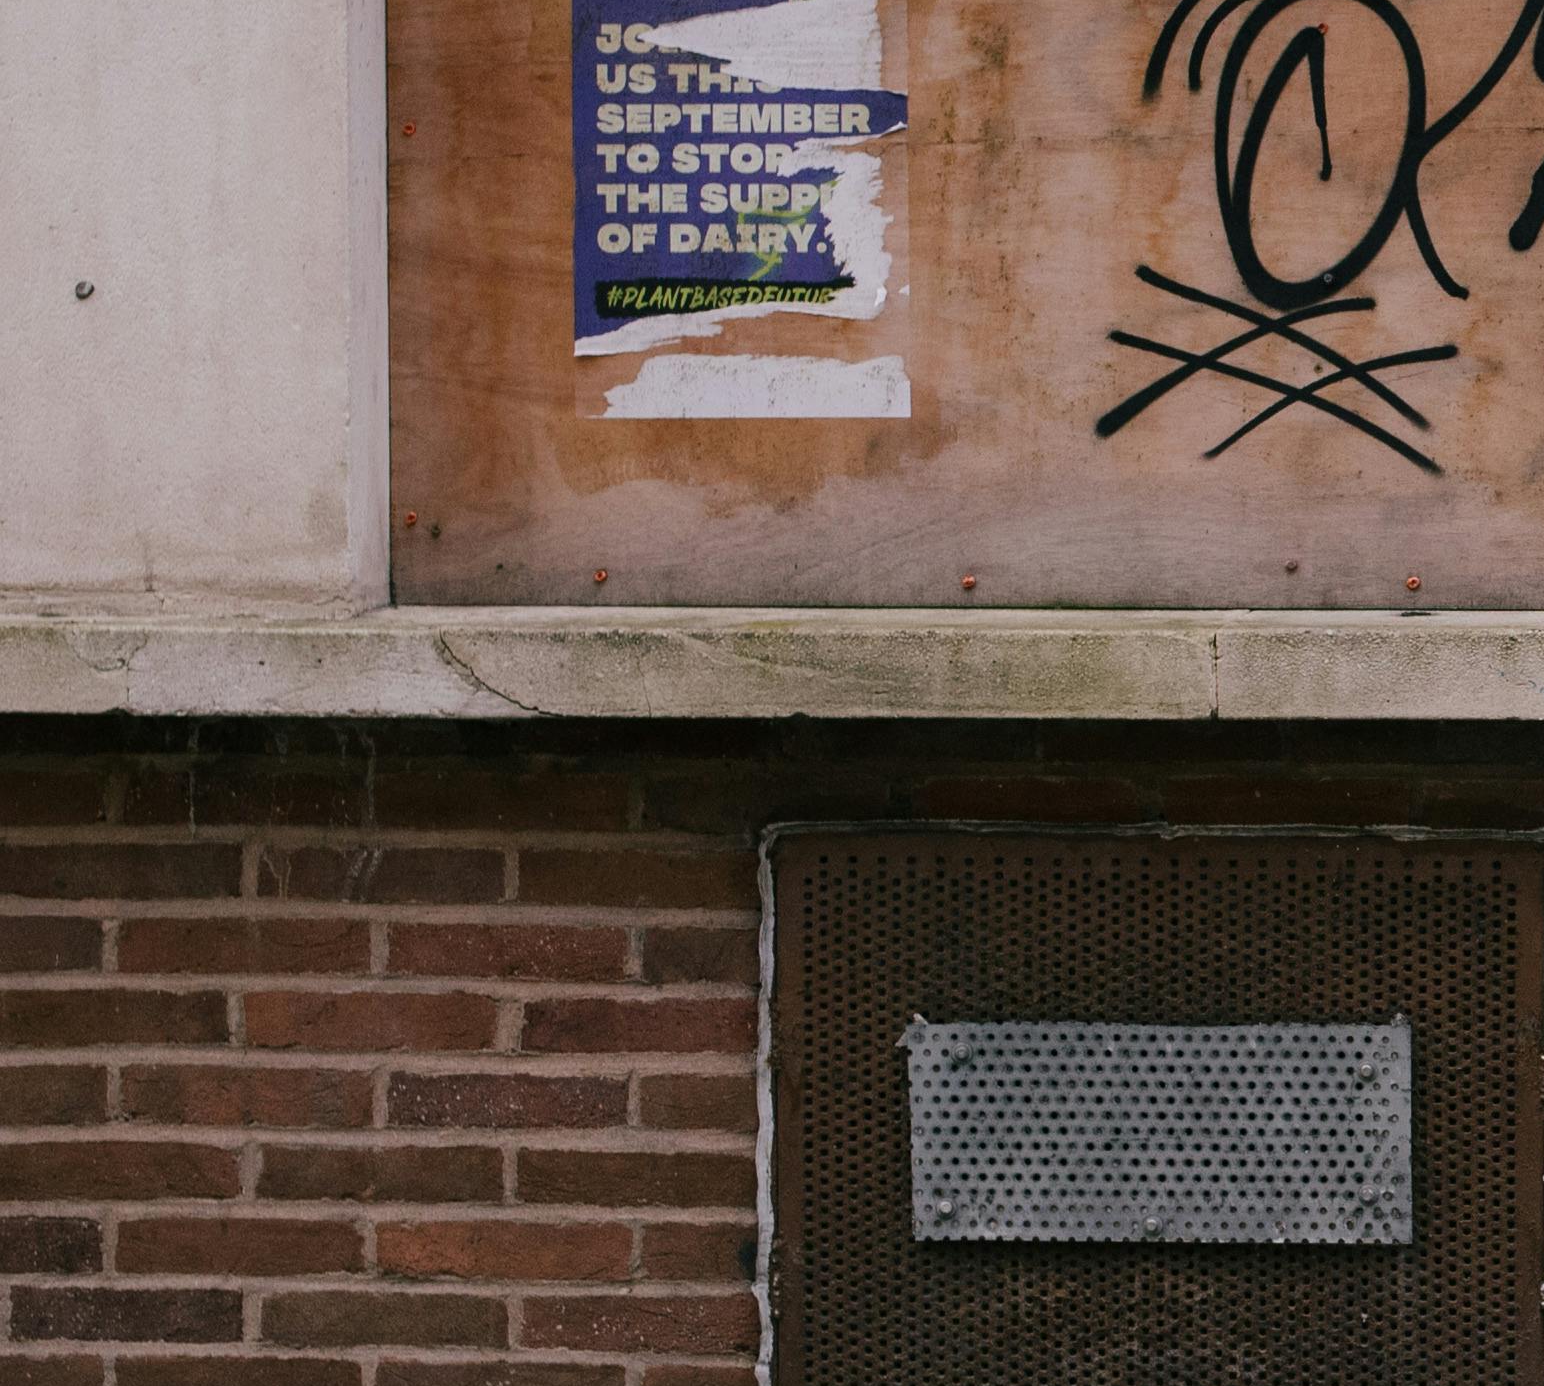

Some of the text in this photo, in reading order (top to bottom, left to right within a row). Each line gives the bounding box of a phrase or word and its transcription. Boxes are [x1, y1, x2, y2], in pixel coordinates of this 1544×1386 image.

[596, 23, 684, 54] JO
[596, 63, 656, 94] US
[596, 103, 871, 134] SEPTEMBER
[596, 143, 661, 174] TO
[597, 183, 689, 214] THE
[597, 223, 828, 254] OF DAIRY.
